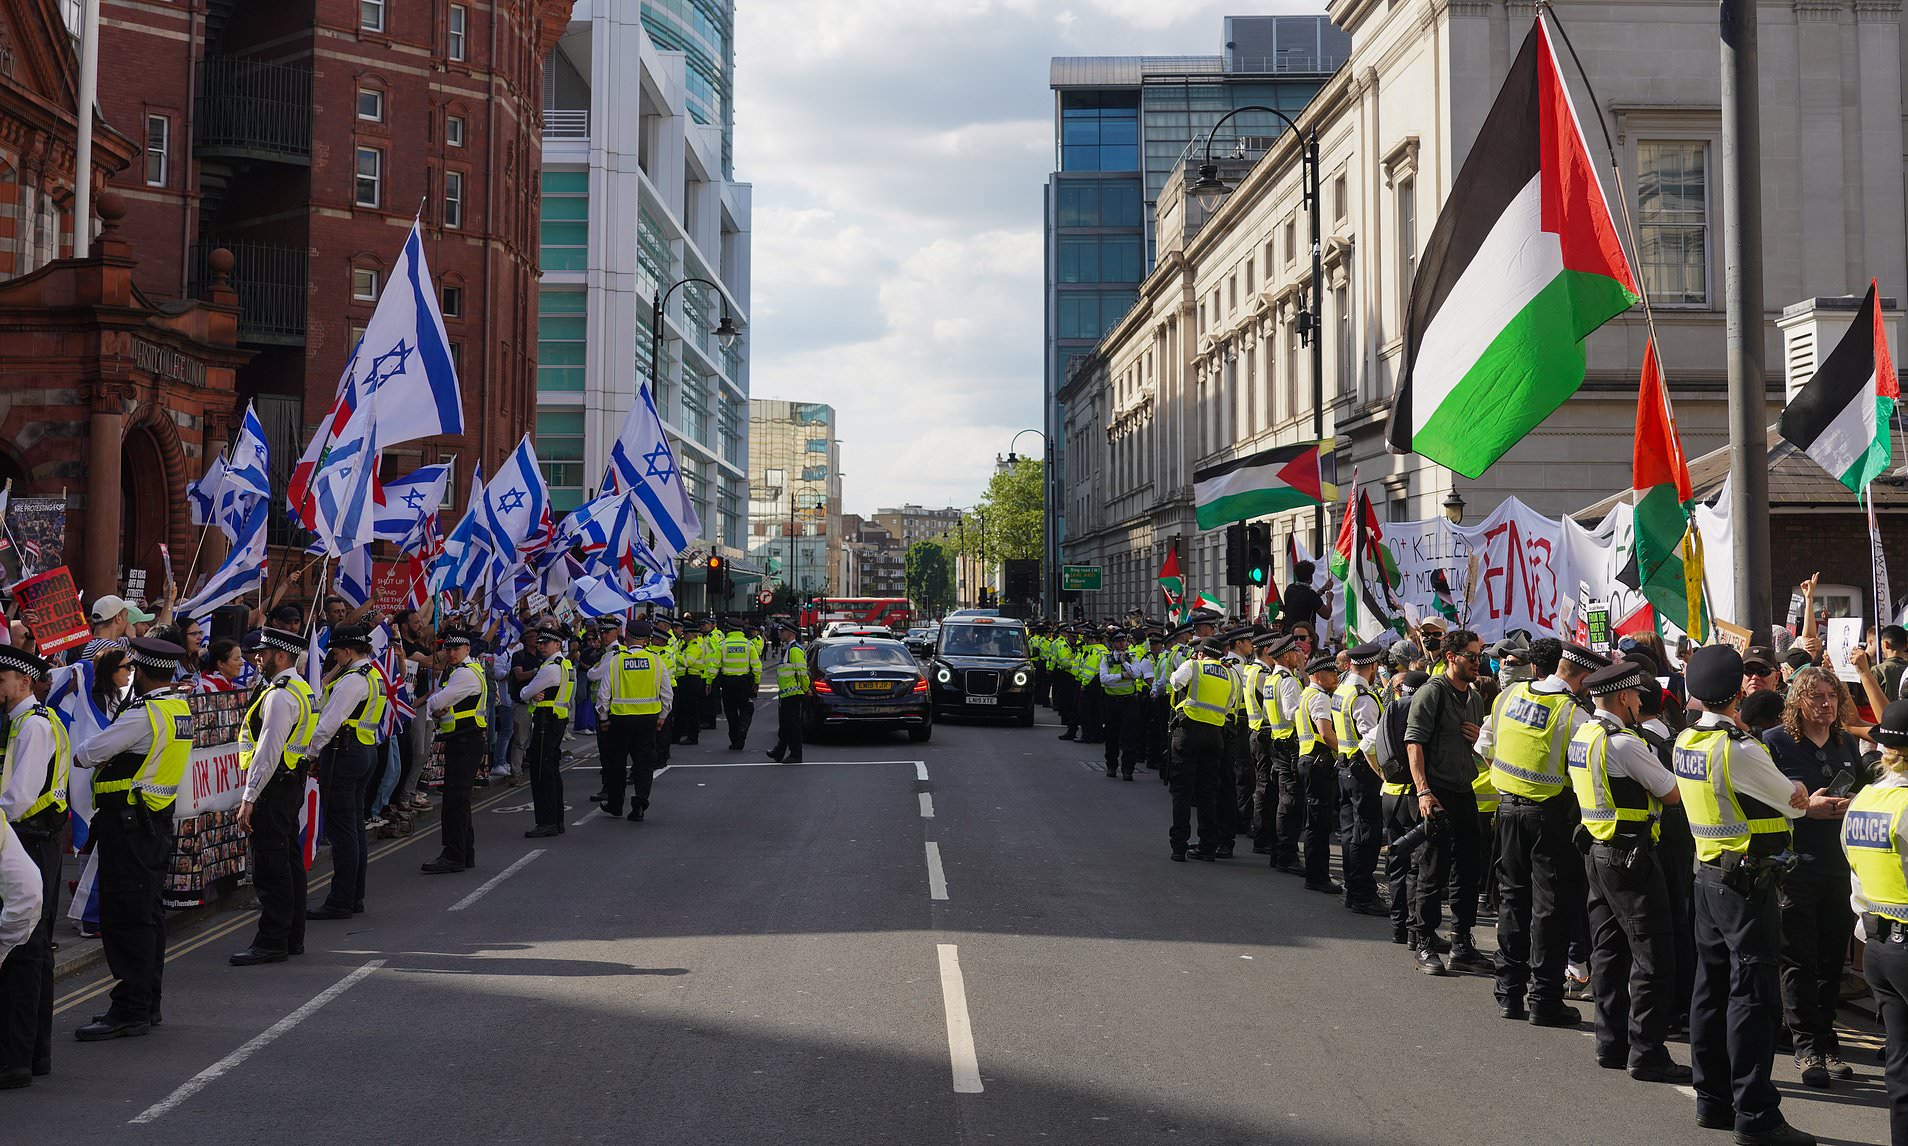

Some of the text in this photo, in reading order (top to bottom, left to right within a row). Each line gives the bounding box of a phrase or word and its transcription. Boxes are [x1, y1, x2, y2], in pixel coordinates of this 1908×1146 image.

[1412, 532, 1474, 562] KILLED
[16, 573, 72, 604] TERROR
[53, 597, 80, 618] OUR
[624, 659, 650, 669] POLICE
[1508, 699, 1547, 725] POLICE
[1568, 742, 1587, 764] OLICE
[1675, 751, 1705, 775] POLICE
[1846, 817, 1888, 842] POLICE
